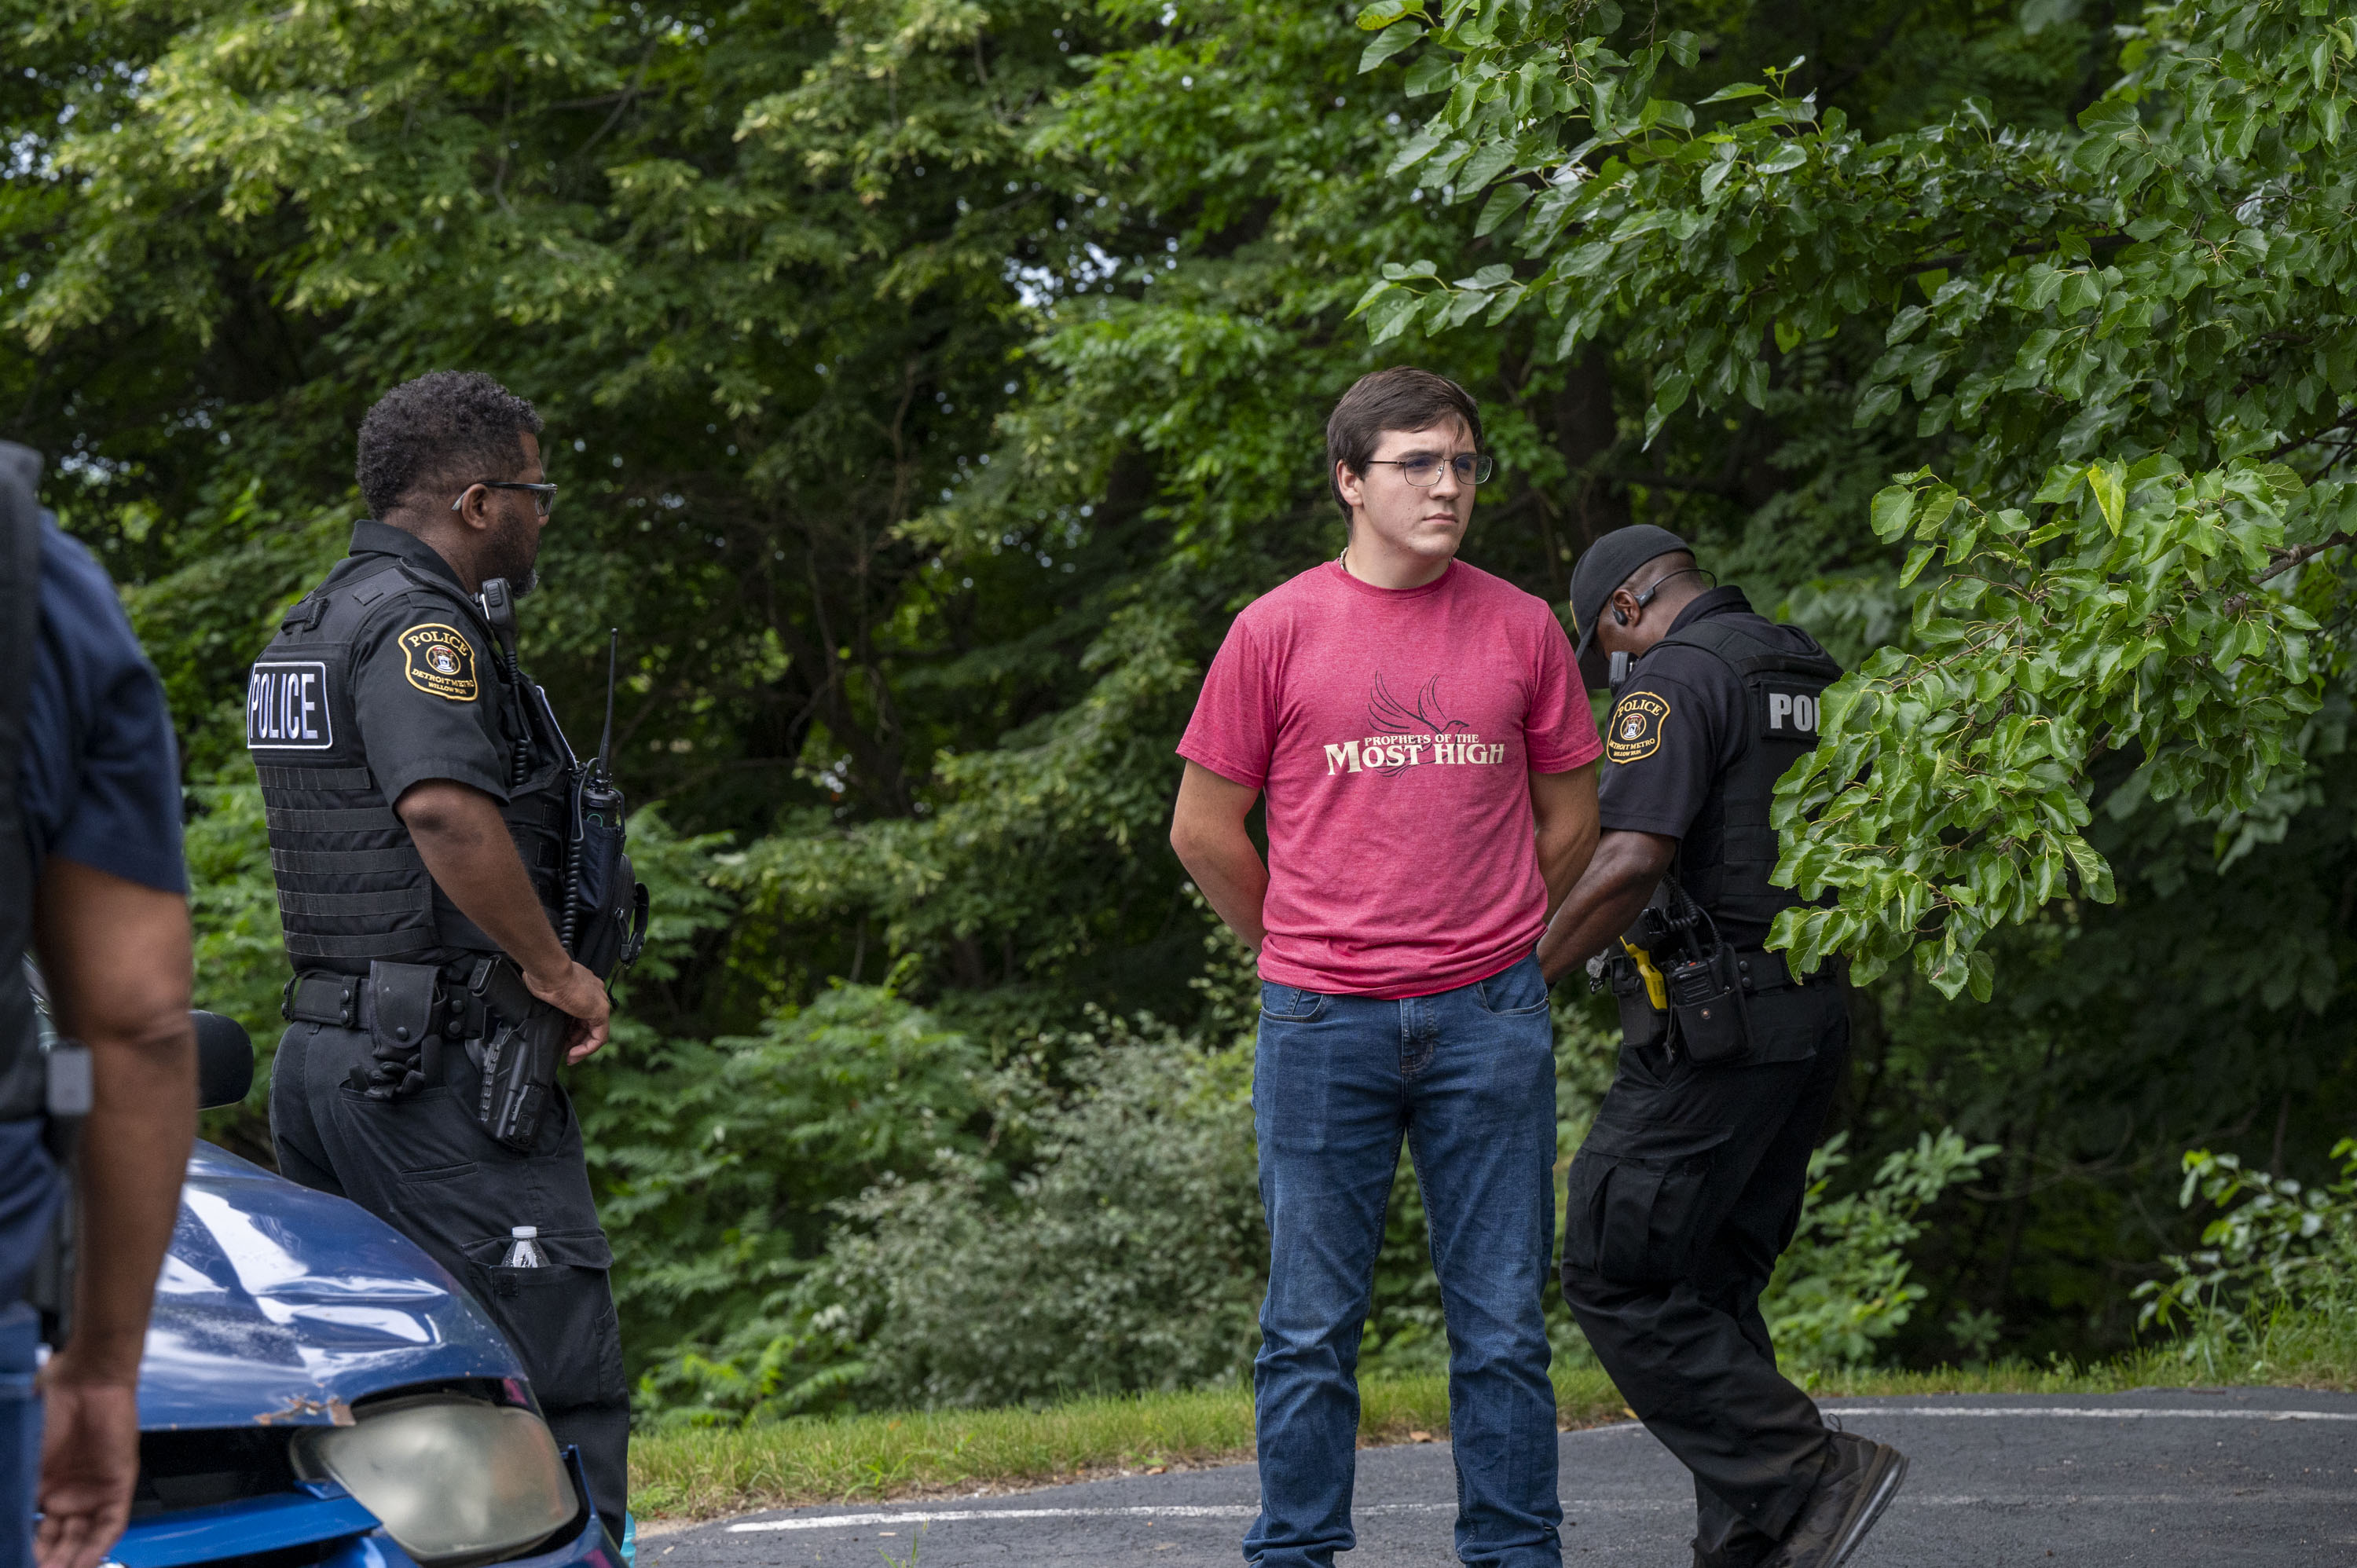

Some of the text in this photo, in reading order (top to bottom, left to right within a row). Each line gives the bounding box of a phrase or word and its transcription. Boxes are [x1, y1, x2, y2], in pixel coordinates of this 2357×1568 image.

[408, 631, 469, 657] POLICE
[411, 669, 451, 685] DETROIT
[250, 672, 318, 739] POLICE
[1618, 699, 1663, 717] POLICE
[1364, 734, 1479, 747] PROPHETS OF THE
[1630, 738, 1655, 749] METRO
[1323, 740, 1505, 776] MOST HIGH
